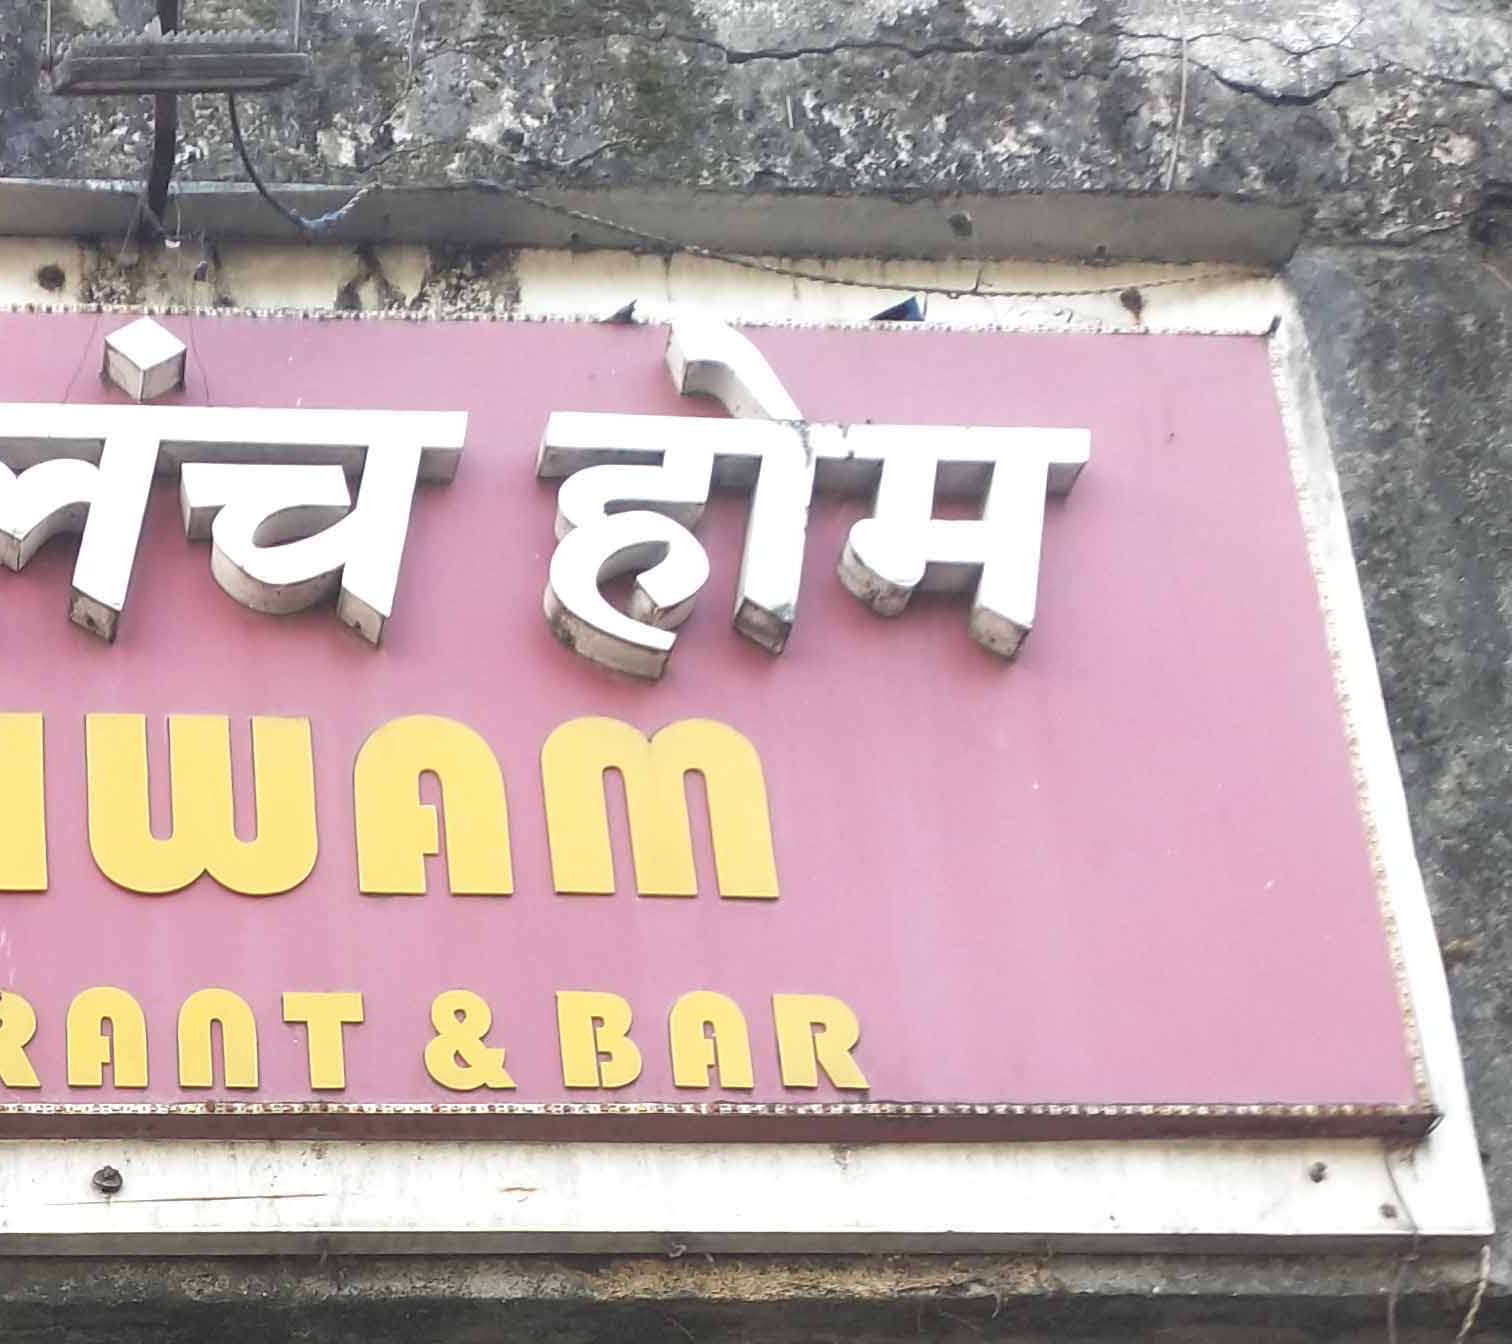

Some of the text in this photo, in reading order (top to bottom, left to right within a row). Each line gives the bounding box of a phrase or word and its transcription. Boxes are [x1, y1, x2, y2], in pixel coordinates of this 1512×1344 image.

[535, 318, 1090, 681] होम
[424, 989, 516, 1091] &
[556, 990, 869, 1092] BAR
